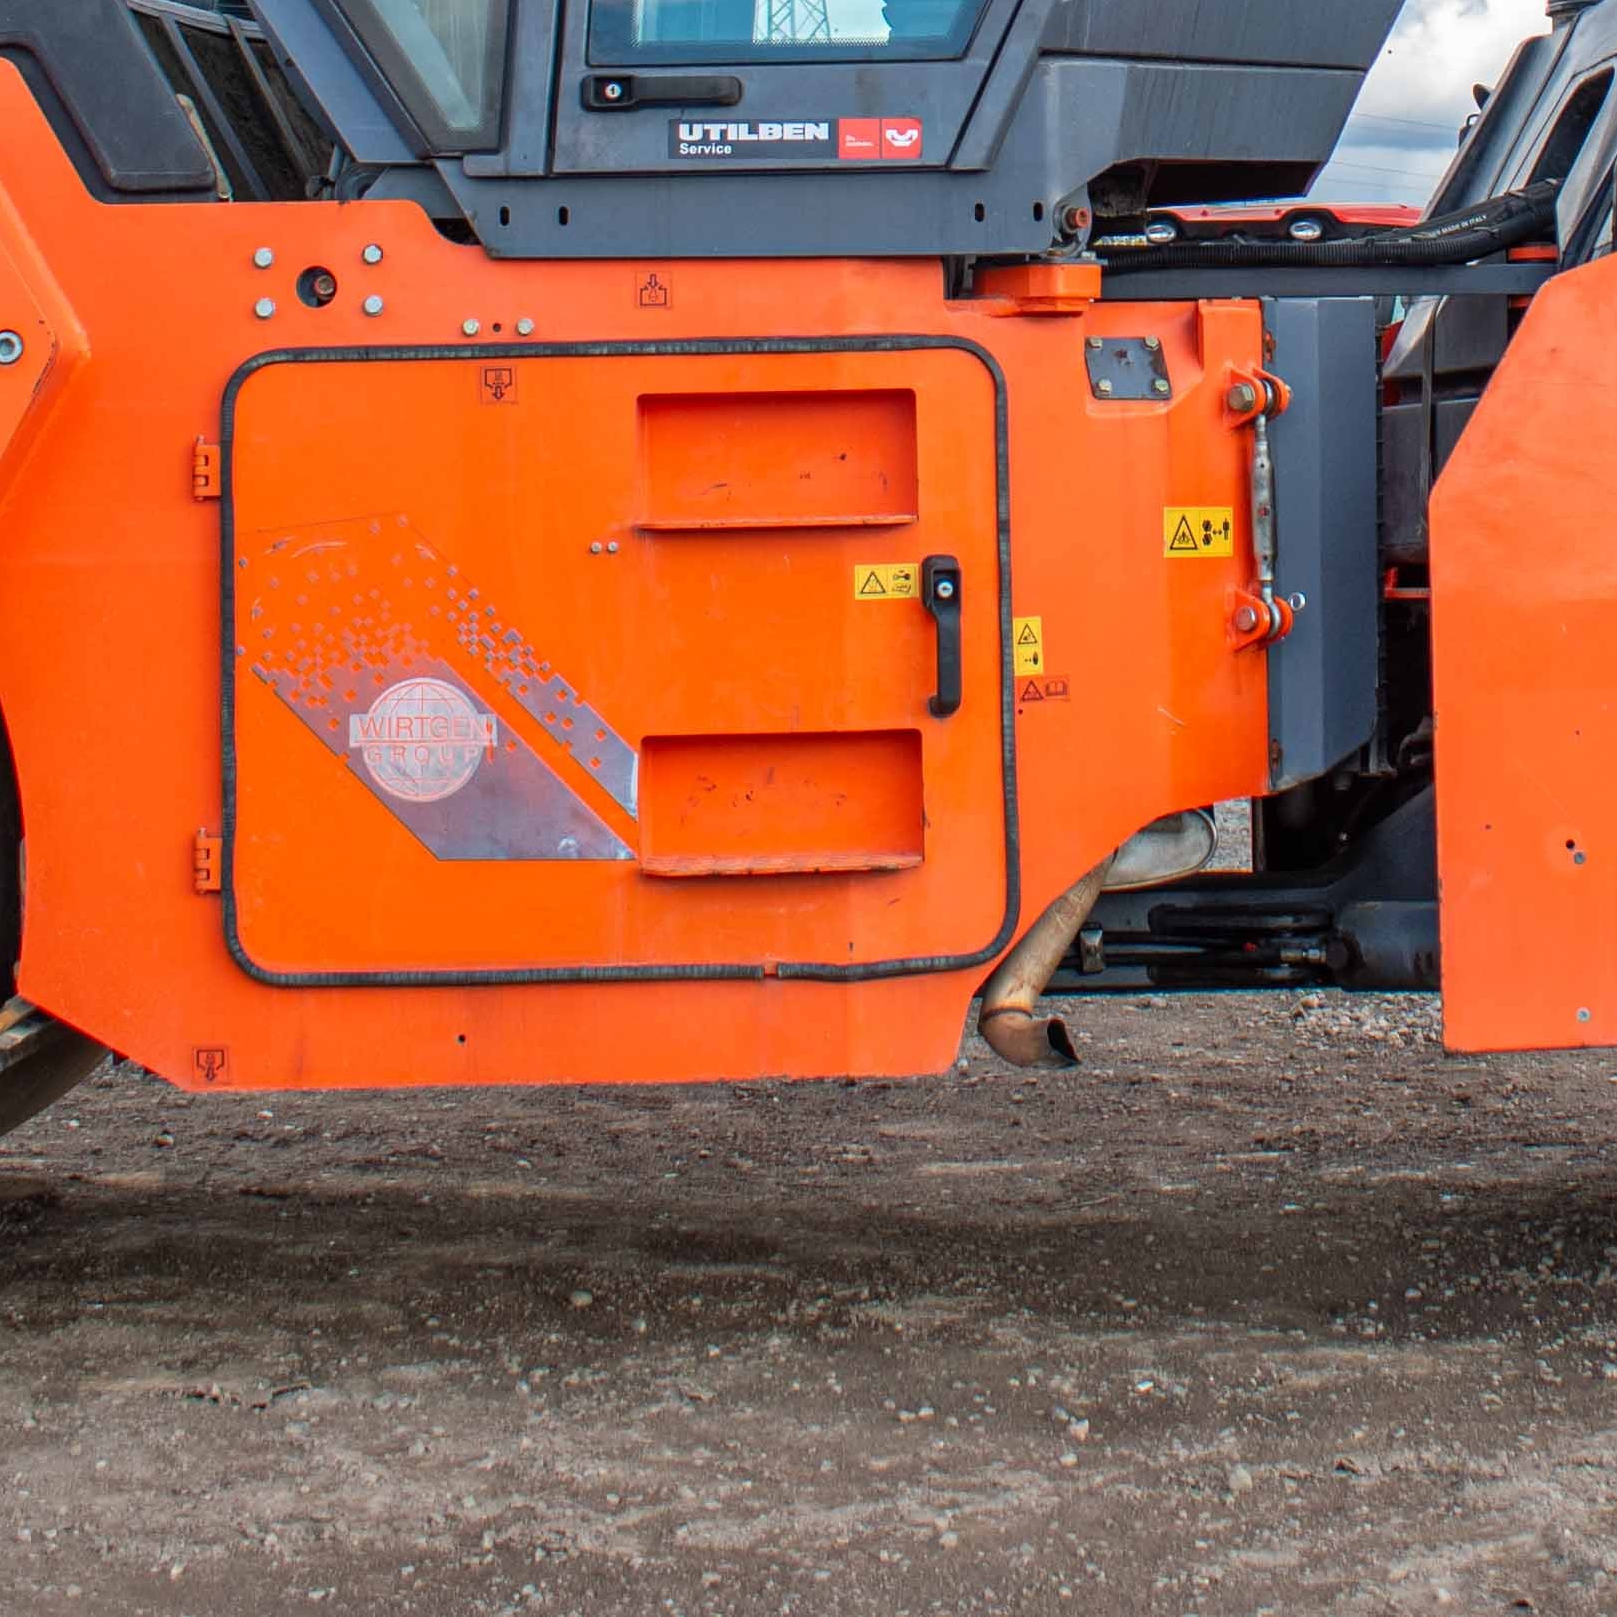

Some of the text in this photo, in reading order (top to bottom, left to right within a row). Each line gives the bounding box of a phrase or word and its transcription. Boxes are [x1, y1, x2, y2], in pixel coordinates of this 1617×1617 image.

[678, 122, 830, 142] UTILBEN
[678, 142, 733, 155] Service
[357, 715, 492, 739] WIRTGEN
[366, 744, 480, 765] GROUP
